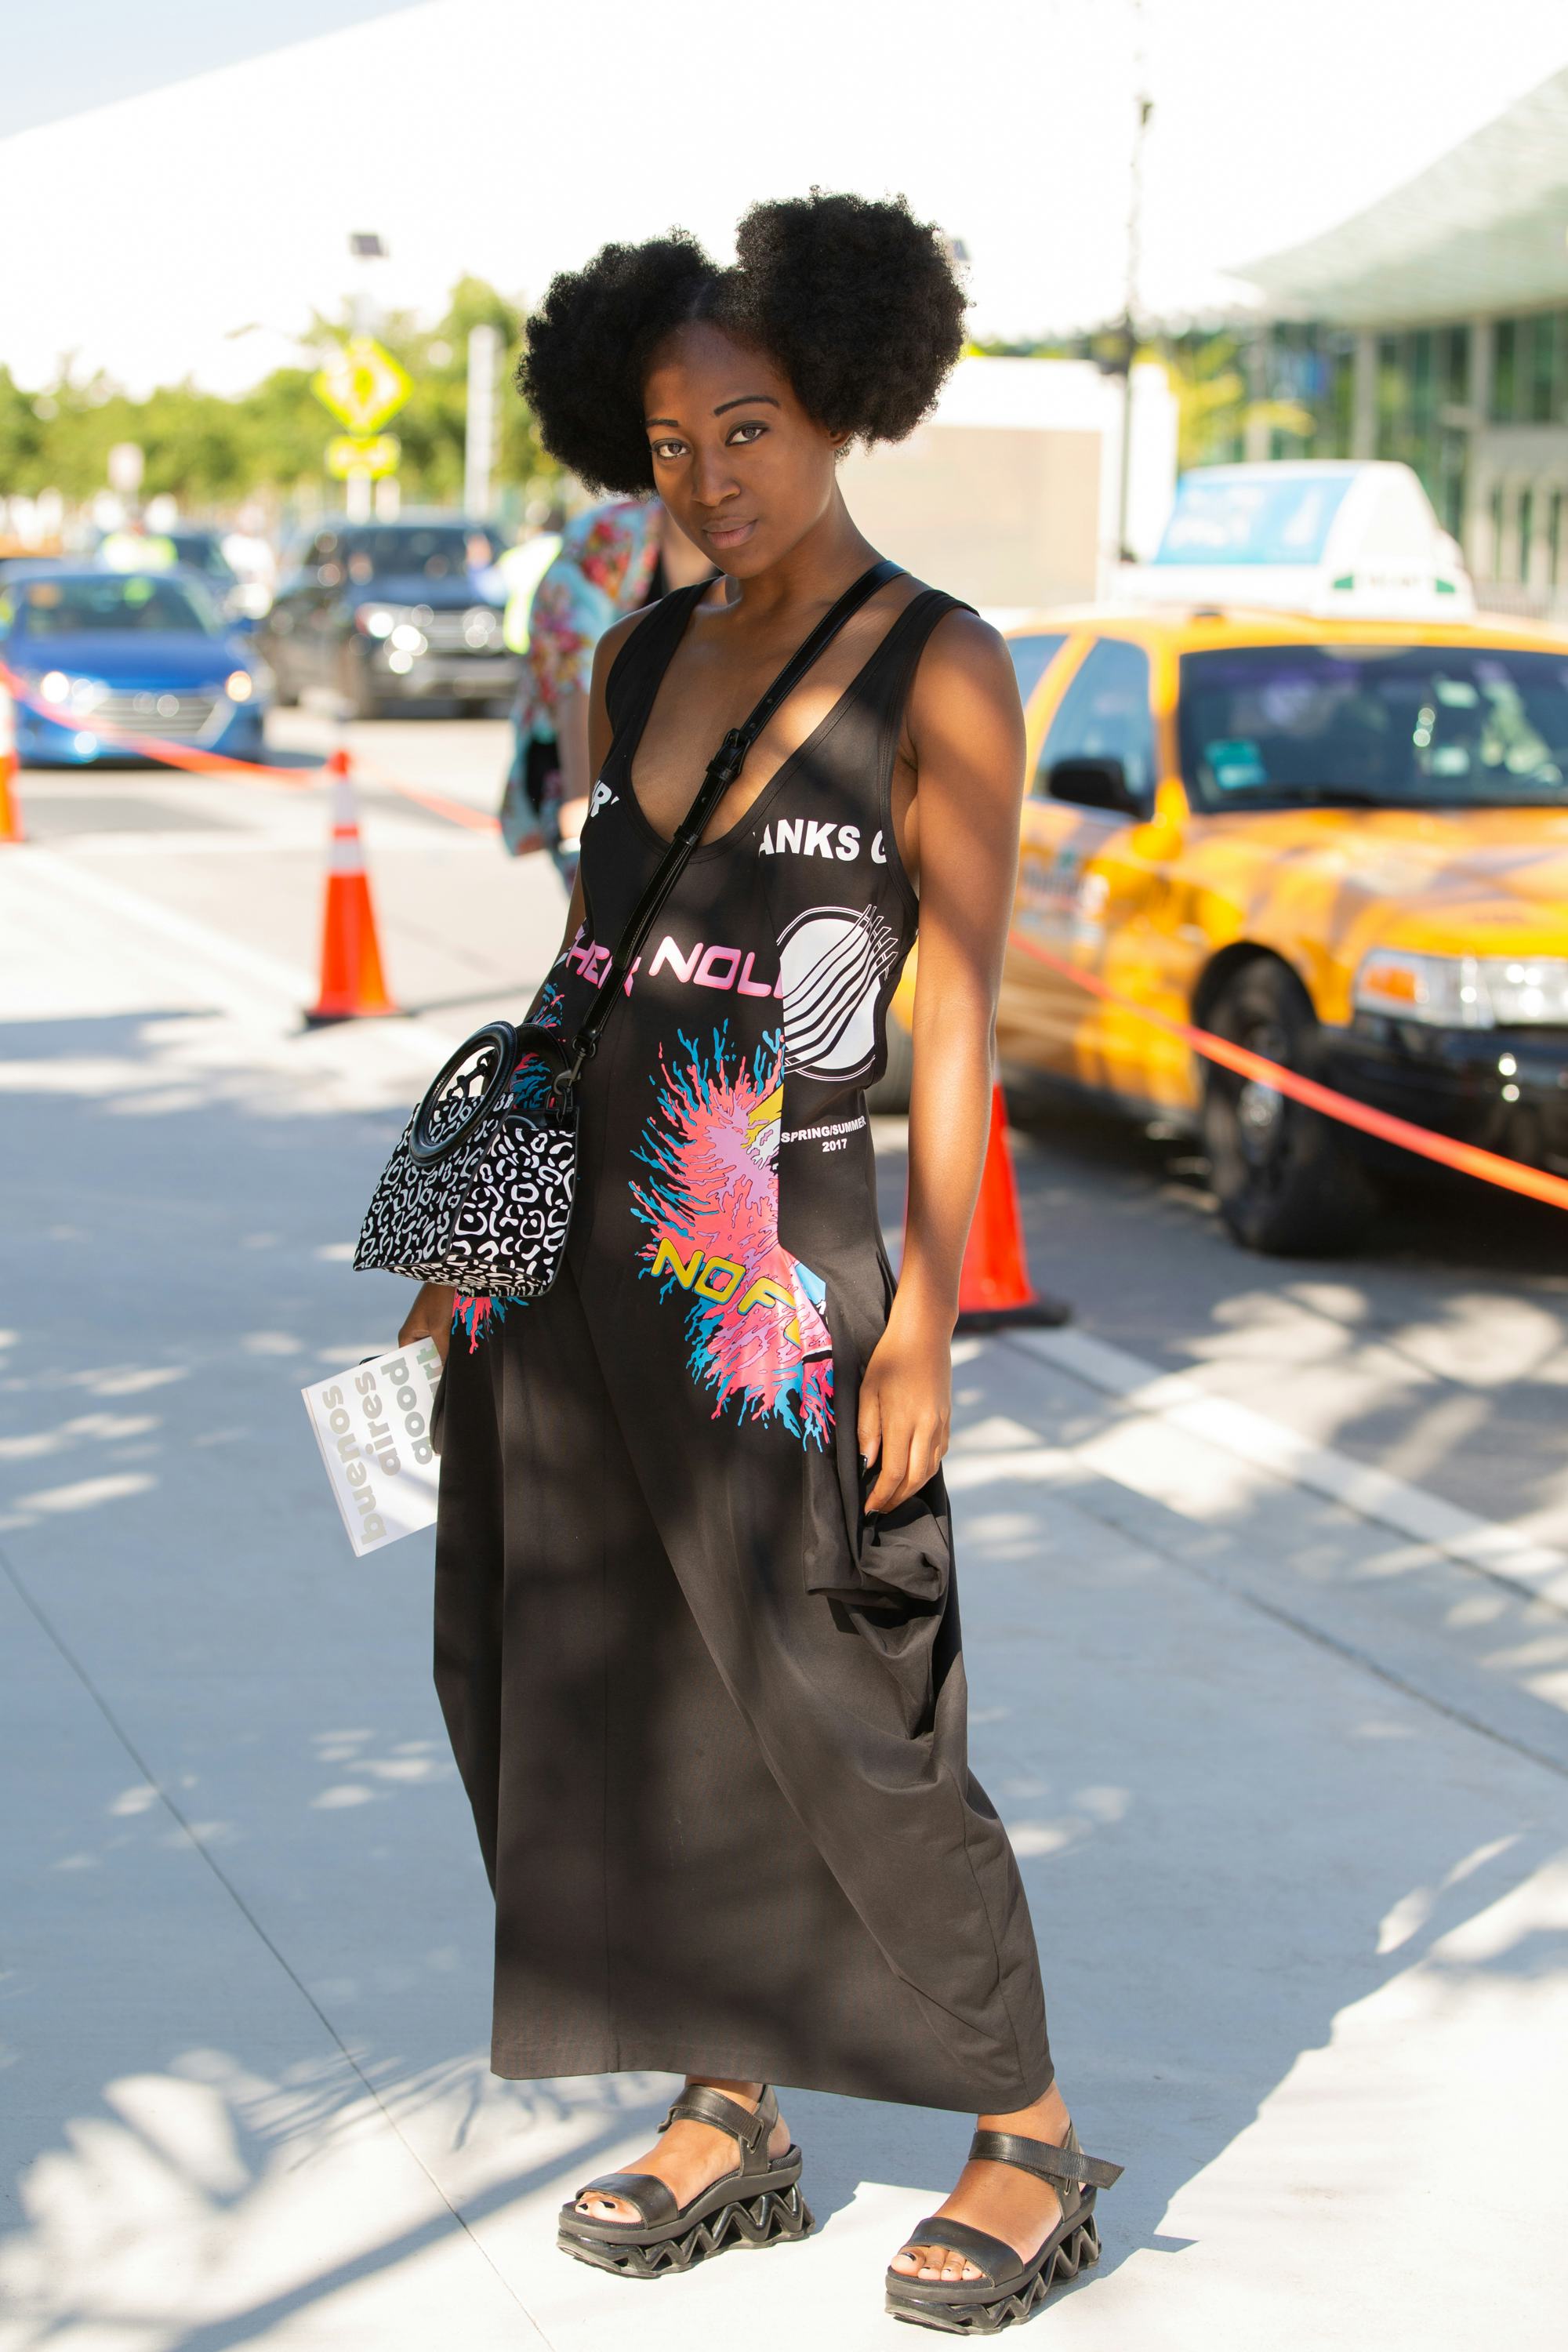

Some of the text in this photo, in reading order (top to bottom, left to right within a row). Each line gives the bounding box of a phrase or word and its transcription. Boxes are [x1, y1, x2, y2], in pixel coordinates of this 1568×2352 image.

[648, 936, 784, 1000] NOL
[780, 1115, 867, 1144] SPRING/SUMMER
[822, 1138, 848, 1153] 2017
[650, 1236, 803, 1351] NOF
[321, 1385, 388, 1545] buenos
[354, 1370, 401, 1477] aires
